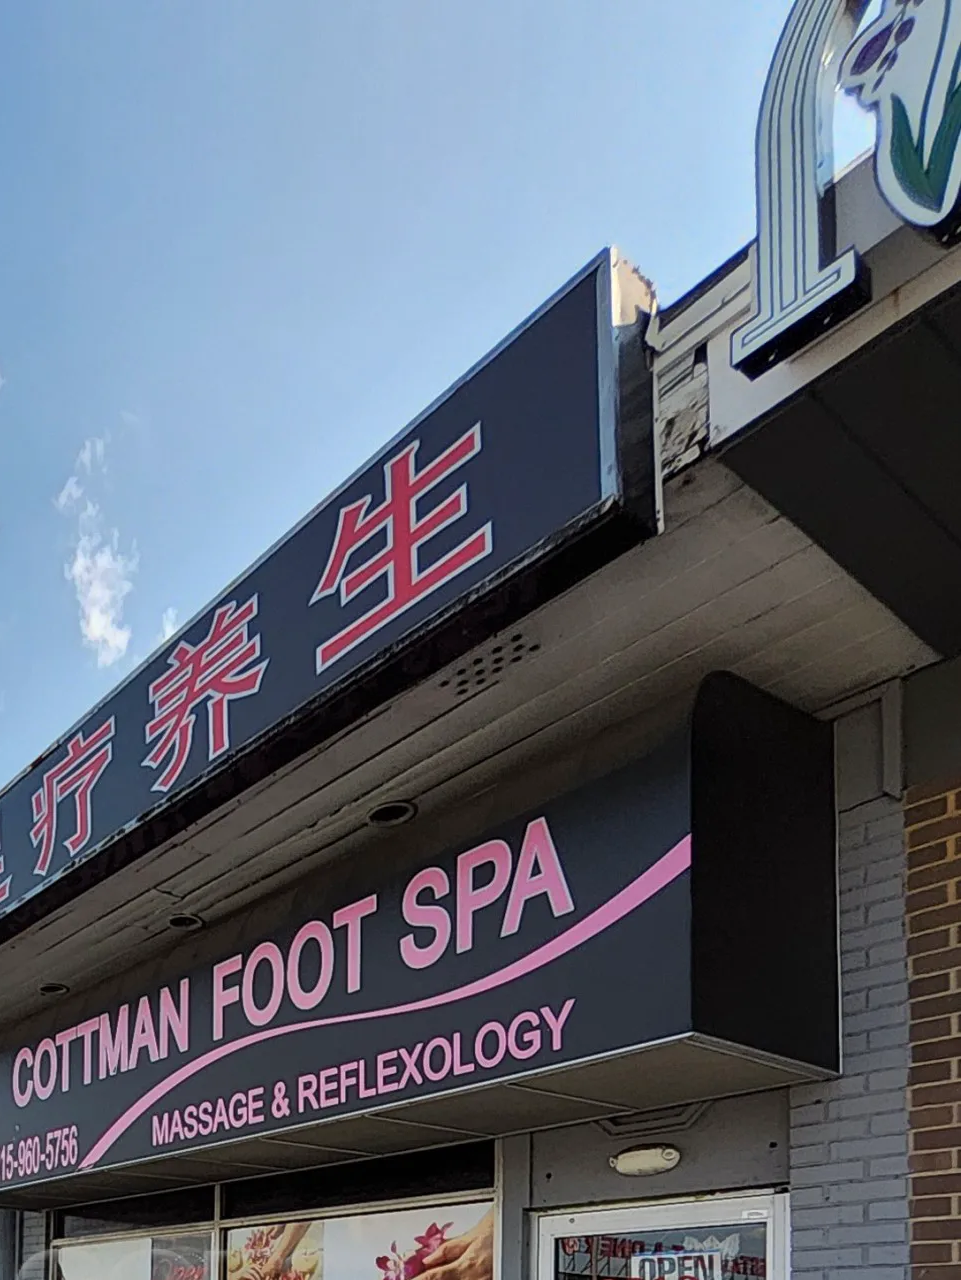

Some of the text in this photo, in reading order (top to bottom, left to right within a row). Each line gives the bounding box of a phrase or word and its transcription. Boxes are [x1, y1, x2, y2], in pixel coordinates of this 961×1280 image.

[12, 816, 575, 1108] COTTMAN FOOT SPA
[151, 998, 576, 1147] MASSAGE & REFLEXOLOGY
